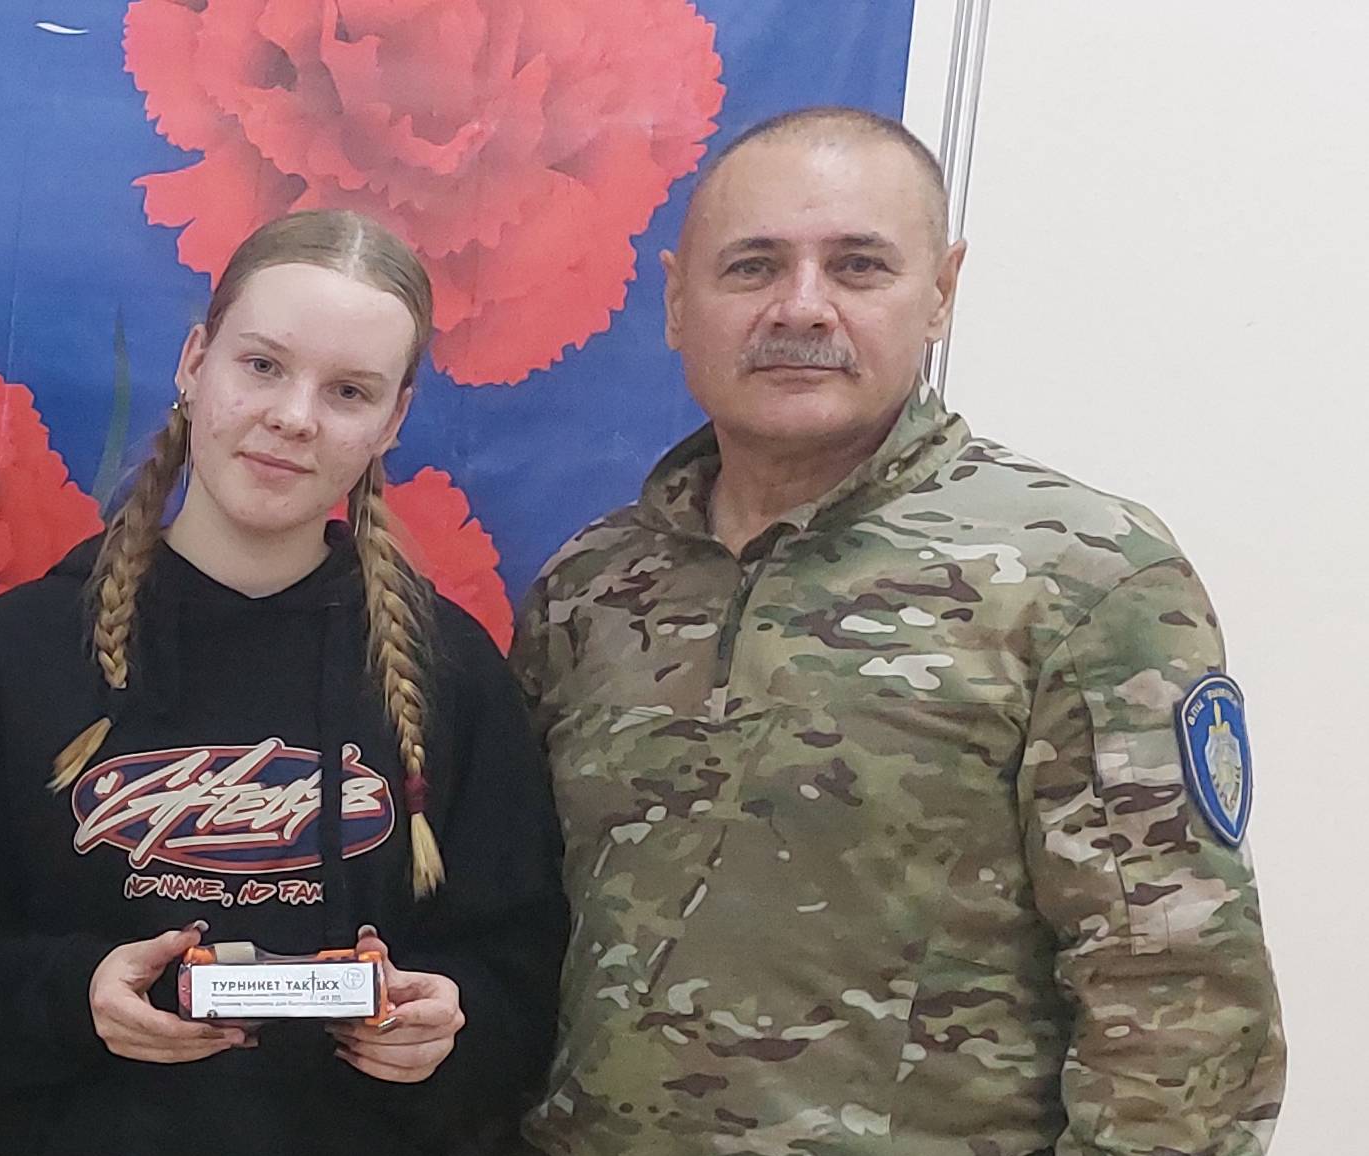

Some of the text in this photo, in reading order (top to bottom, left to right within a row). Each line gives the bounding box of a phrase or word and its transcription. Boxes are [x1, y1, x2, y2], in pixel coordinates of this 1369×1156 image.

[125, 874, 158, 900] NO
[237, 878, 276, 904] NO
[212, 981, 280, 991] ТУРНИКЕТ
